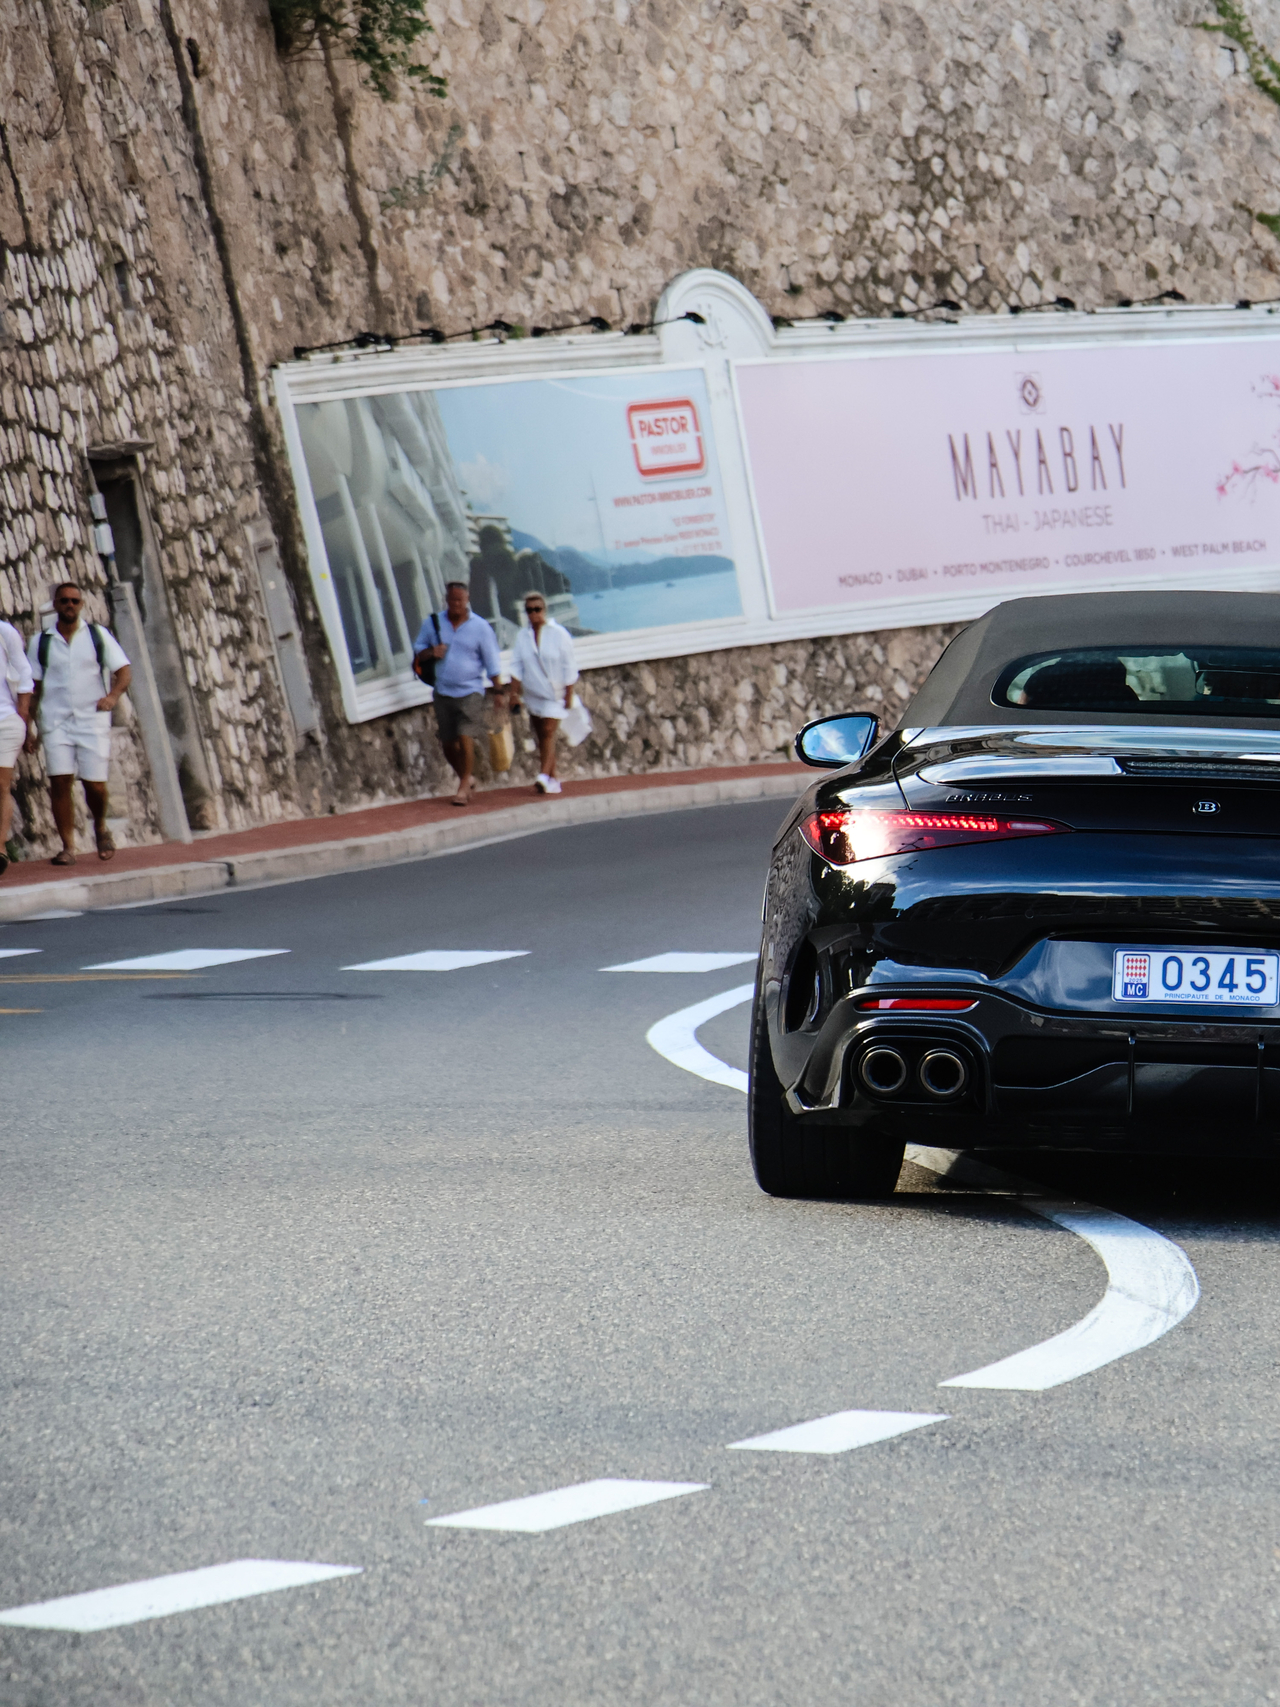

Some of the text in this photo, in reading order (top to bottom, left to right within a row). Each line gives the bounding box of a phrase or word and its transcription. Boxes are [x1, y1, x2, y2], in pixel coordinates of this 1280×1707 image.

[638, 415, 689, 438] PASTOR
[948, 423, 1126, 501] MAYABAY
[982, 506, 1114, 535] THAI JAPANESE
[838, 539, 1267, 587] MONACO DUBAI PORTO MONTENEGRO COURCHEVEL 1850 WEST PALM BEACH
[1162, 956, 1267, 994] 0345
[1127, 984, 1144, 996] MC
[1164, 992, 1209, 1000] PRINCIPAUTE
